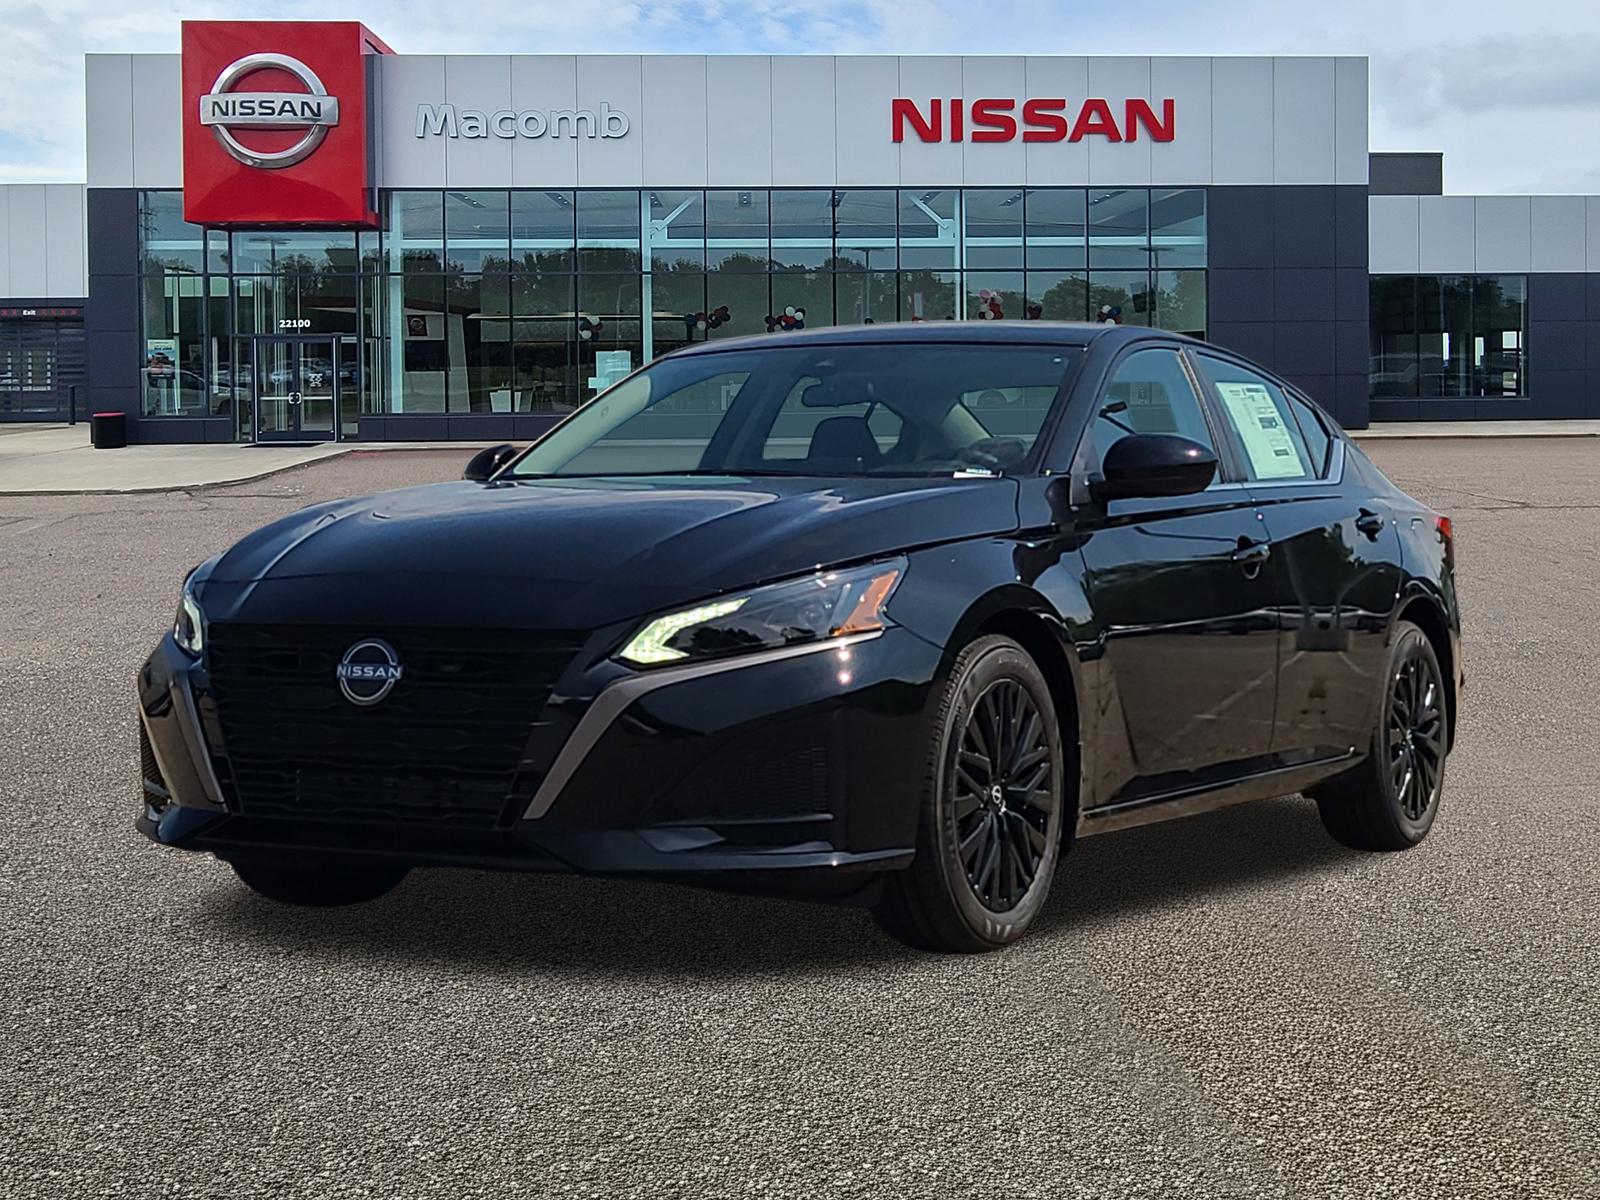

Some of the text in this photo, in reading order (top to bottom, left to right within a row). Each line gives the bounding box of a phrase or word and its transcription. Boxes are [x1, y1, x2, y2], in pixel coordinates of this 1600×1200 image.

[211, 100, 322, 118] NISSAN
[415, 102, 630, 139] Macomb
[892, 98, 1175, 143] NISSAN
[279, 319, 311, 328] 22100
[337, 664, 401, 678] NISSAN
